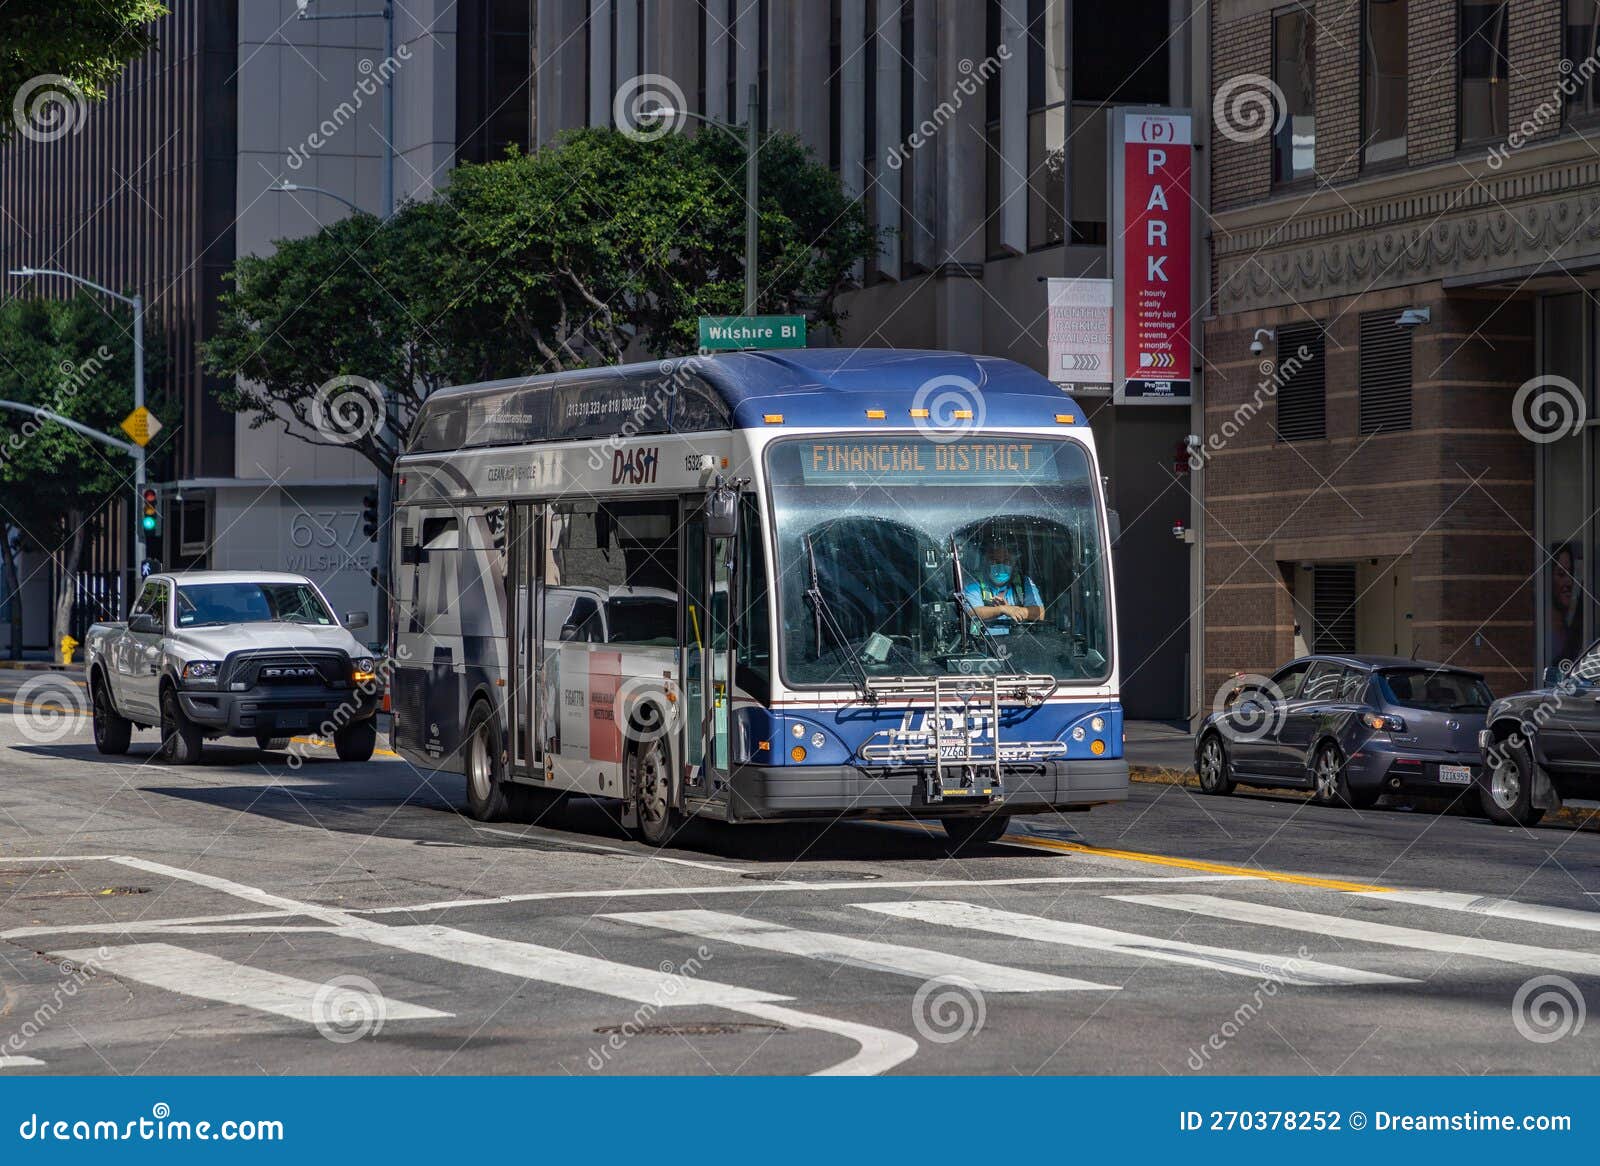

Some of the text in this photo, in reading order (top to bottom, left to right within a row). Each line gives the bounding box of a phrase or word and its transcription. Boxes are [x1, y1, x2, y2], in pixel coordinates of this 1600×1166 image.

[1146, 149, 1168, 281] PARK
[1144, 289, 1166, 299] hourly
[1144, 300, 1160, 309] daily
[1144, 310, 1176, 319] early bird
[1055, 320, 1106, 331] PARKING
[1144, 321, 1175, 330] evenings
[709, 325, 796, 340] Wilshire Bl
[1144, 341, 1172, 351] monthly
[812, 444, 1033, 471] FINANCIAL DISTRICT
[611, 447, 659, 485] DASH
[291, 511, 361, 547] 637
[287, 554, 370, 571] WILSHIRE
[266, 668, 315, 677] RAM
